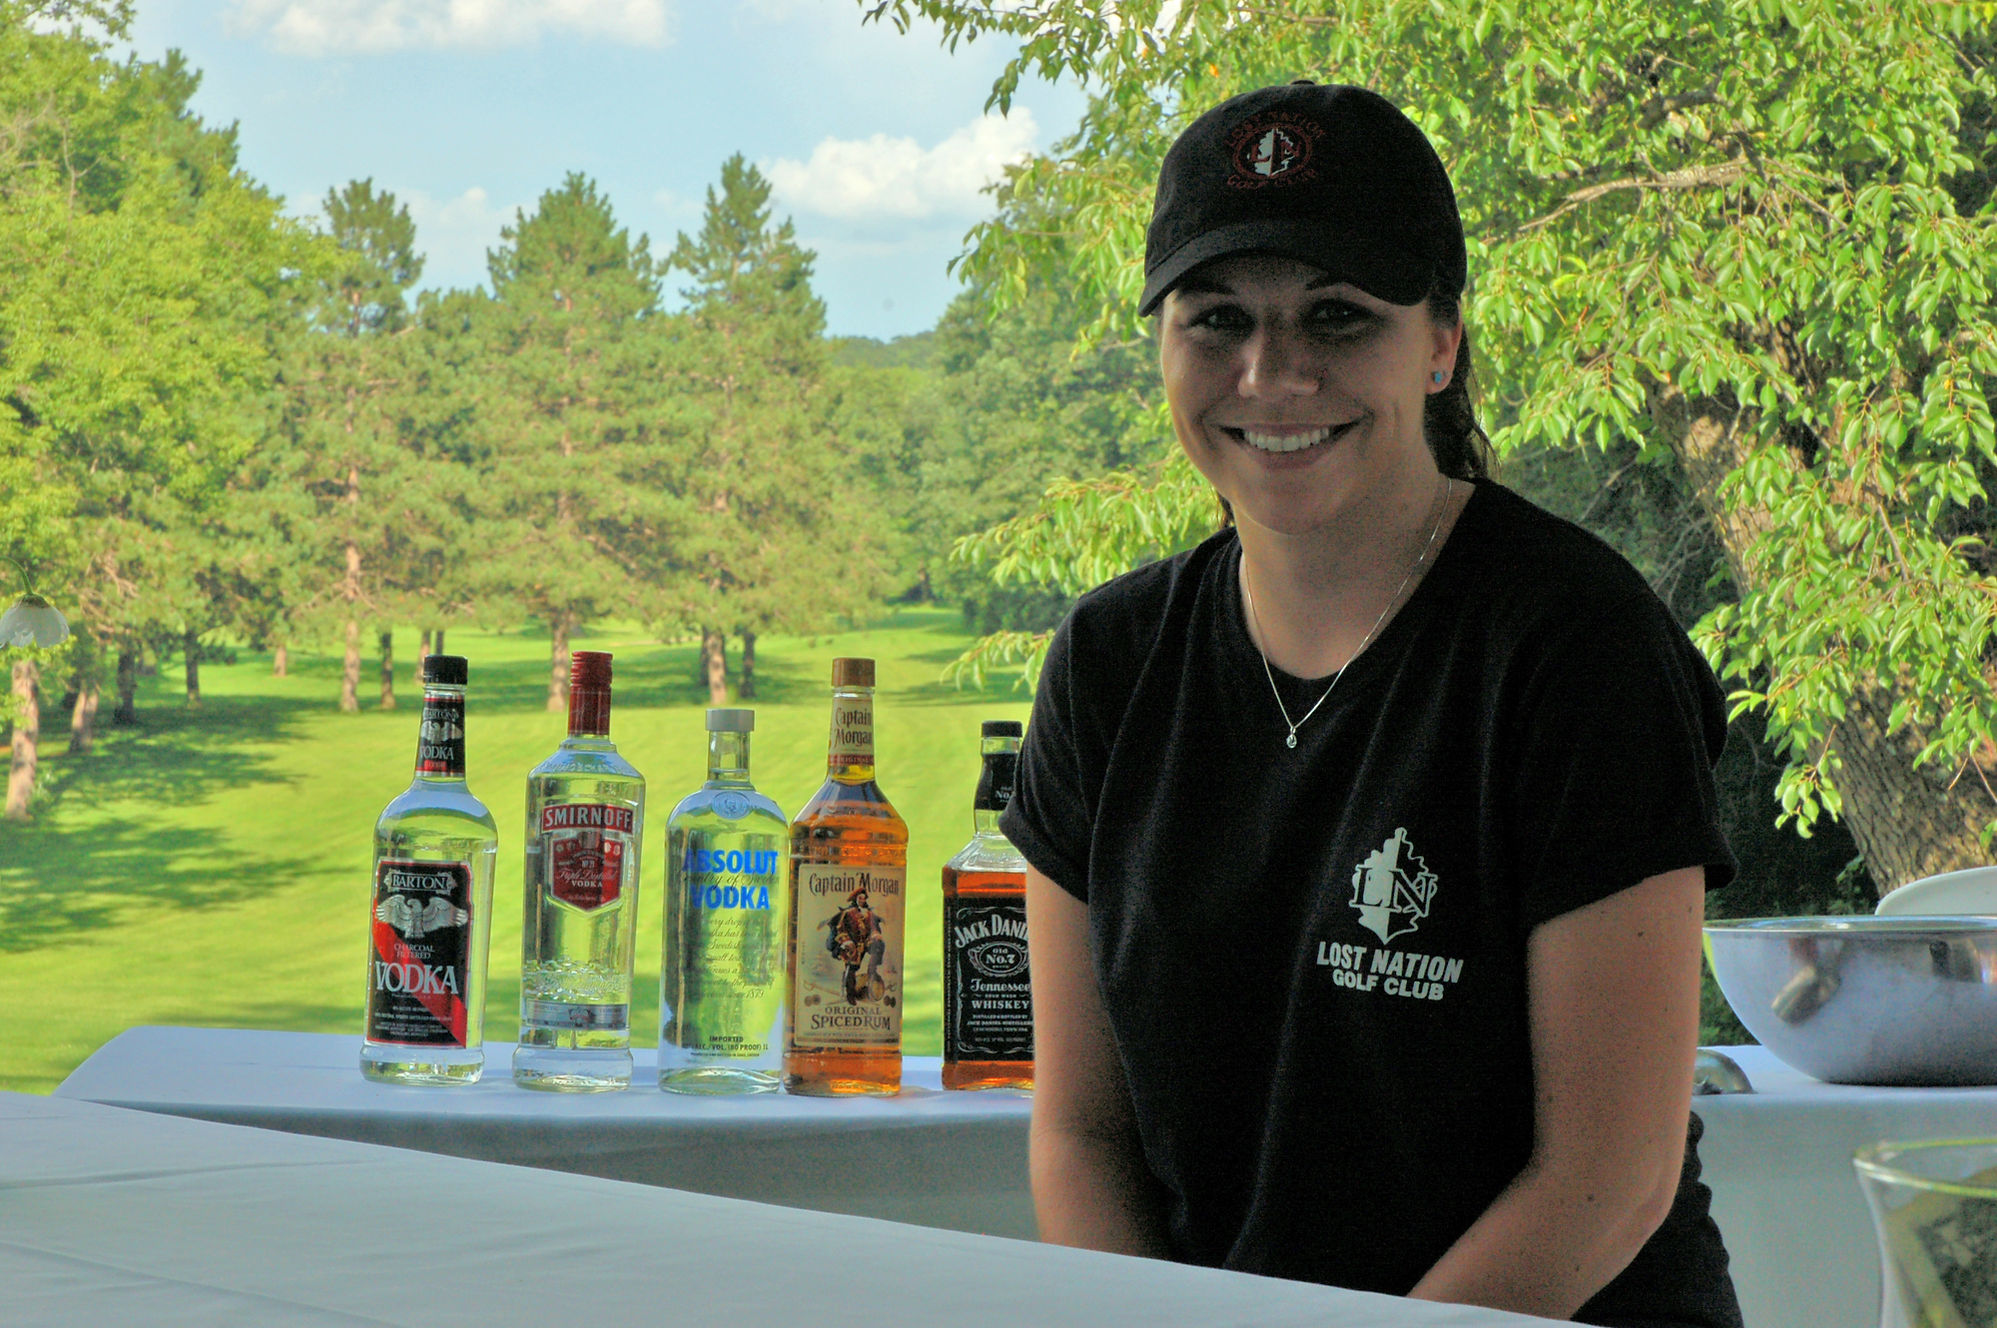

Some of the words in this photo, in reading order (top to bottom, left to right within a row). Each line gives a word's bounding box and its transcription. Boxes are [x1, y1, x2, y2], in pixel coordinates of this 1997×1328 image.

[835, 707, 873, 728] Captain
[833, 728, 873, 748] Morgan
[420, 745, 454, 760] VODKA
[545, 807, 631, 829] SMIRNOFF
[682, 849, 779, 875] ABSOLUT
[392, 874, 446, 889] BARTON
[571, 880, 604, 888] VODKA
[809, 872, 855, 896] Captain
[855, 872, 900, 897] Morgan
[690, 885, 771, 910] VODKA
[954, 920, 991, 949] JACK
[991, 914, 1030, 941] DANI
[985, 953, 1016, 965] No.7
[1316, 941, 1367, 971] LOST
[1370, 948, 1464, 984] NATION
[375, 961, 459, 994] VODKA
[970, 978, 1032, 992] Tennessee
[1332, 968, 1379, 992] GOLF
[1384, 977, 1445, 1001] CLUB
[825, 1006, 882, 1015] ORIGINAL
[971, 1000, 1030, 1010] WHISKEY
